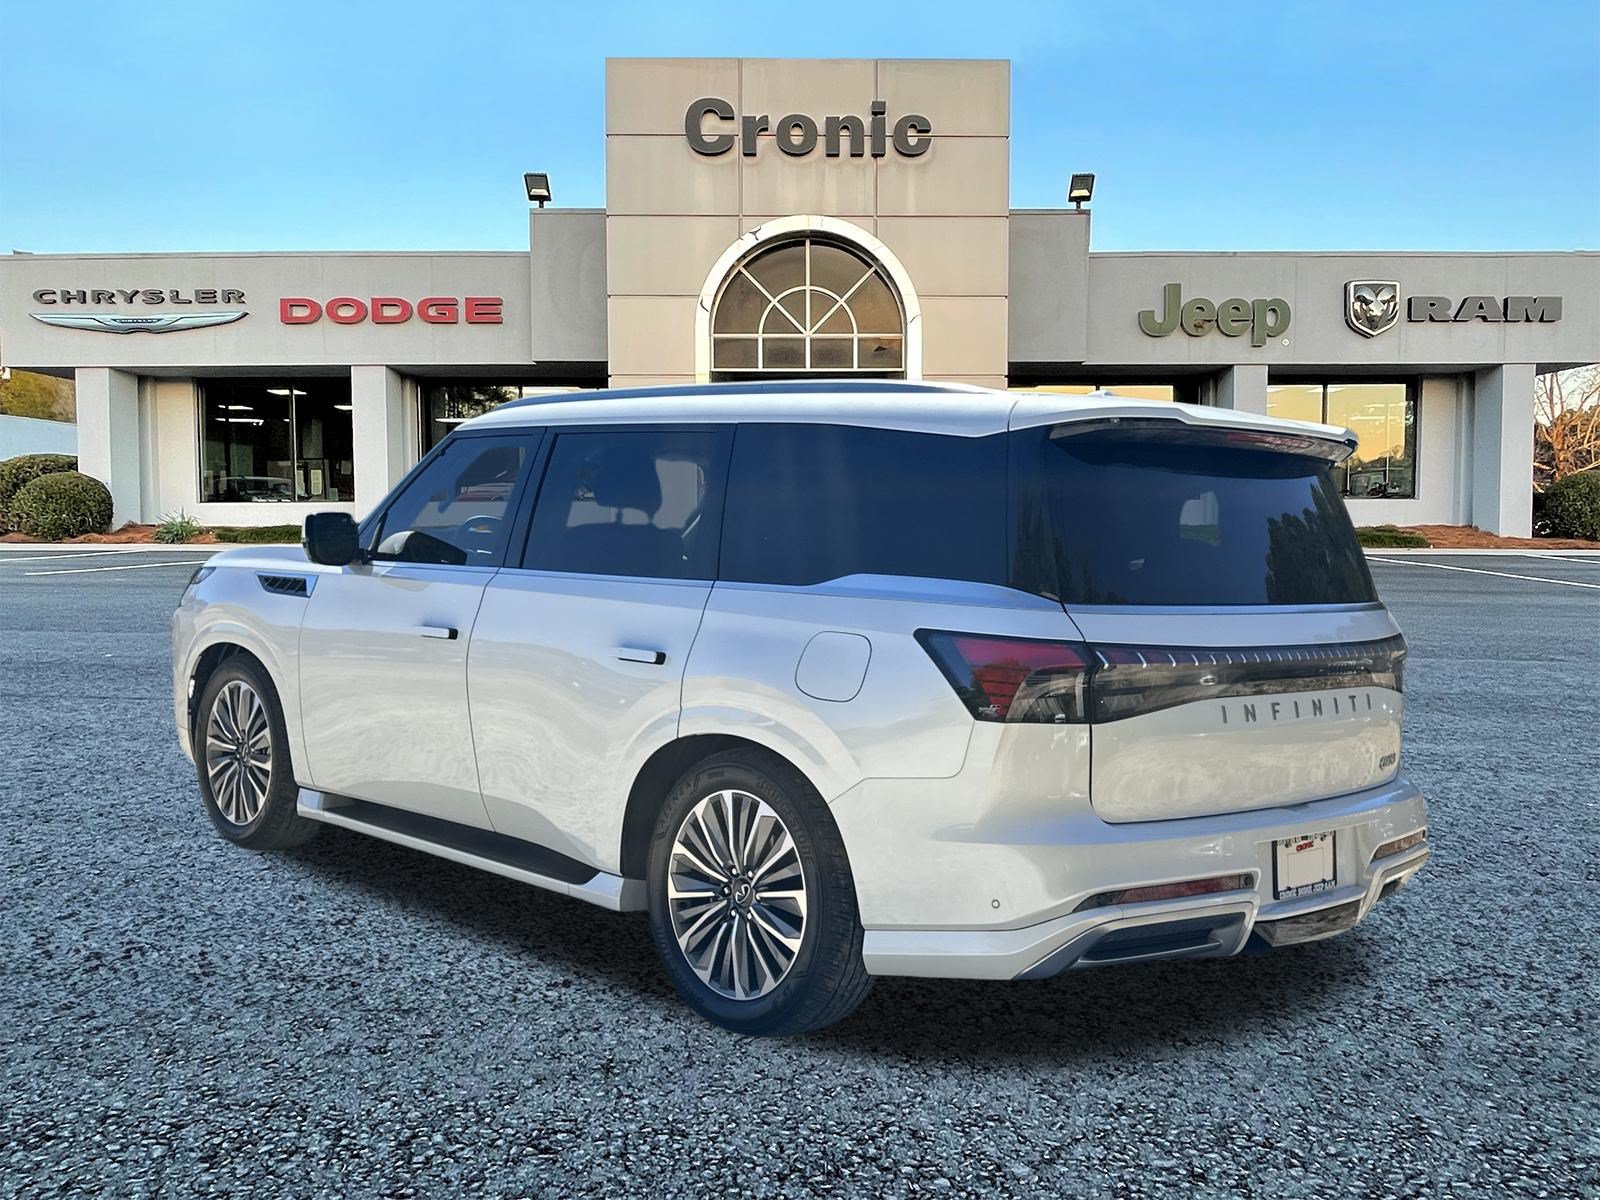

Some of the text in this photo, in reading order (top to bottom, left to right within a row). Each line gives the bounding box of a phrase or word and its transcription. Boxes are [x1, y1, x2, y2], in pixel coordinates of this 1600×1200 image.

[685, 97, 931, 158] Cronic
[33, 288, 247, 305] CHRYSLER
[280, 297, 504, 325] DODGE
[1408, 296, 1563, 323] RAM
[1138, 283, 1292, 347] Jeep
[1221, 693, 1372, 724] INFINITI
